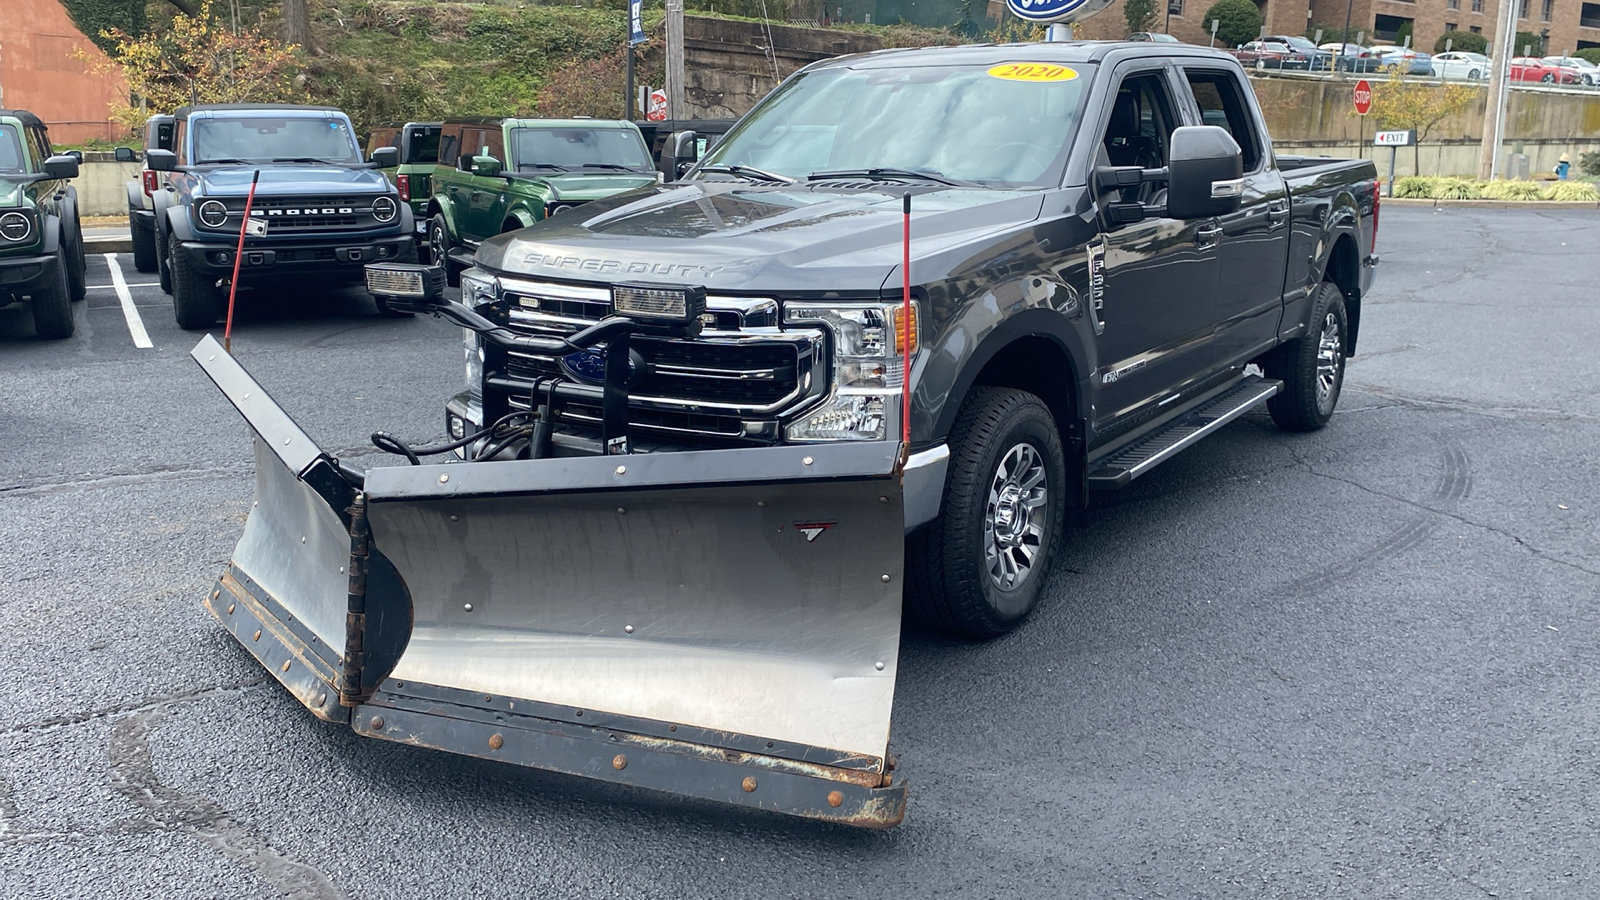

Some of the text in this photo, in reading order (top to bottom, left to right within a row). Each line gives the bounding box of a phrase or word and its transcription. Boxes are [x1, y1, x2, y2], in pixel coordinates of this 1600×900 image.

[1000, 66, 1064, 79] 2020
[1355, 90, 1371, 104] STOP
[1386, 133, 1404, 143] EXIT
[250, 207, 353, 216] BRONCO
[523, 253, 723, 278] SUPER DUTY
